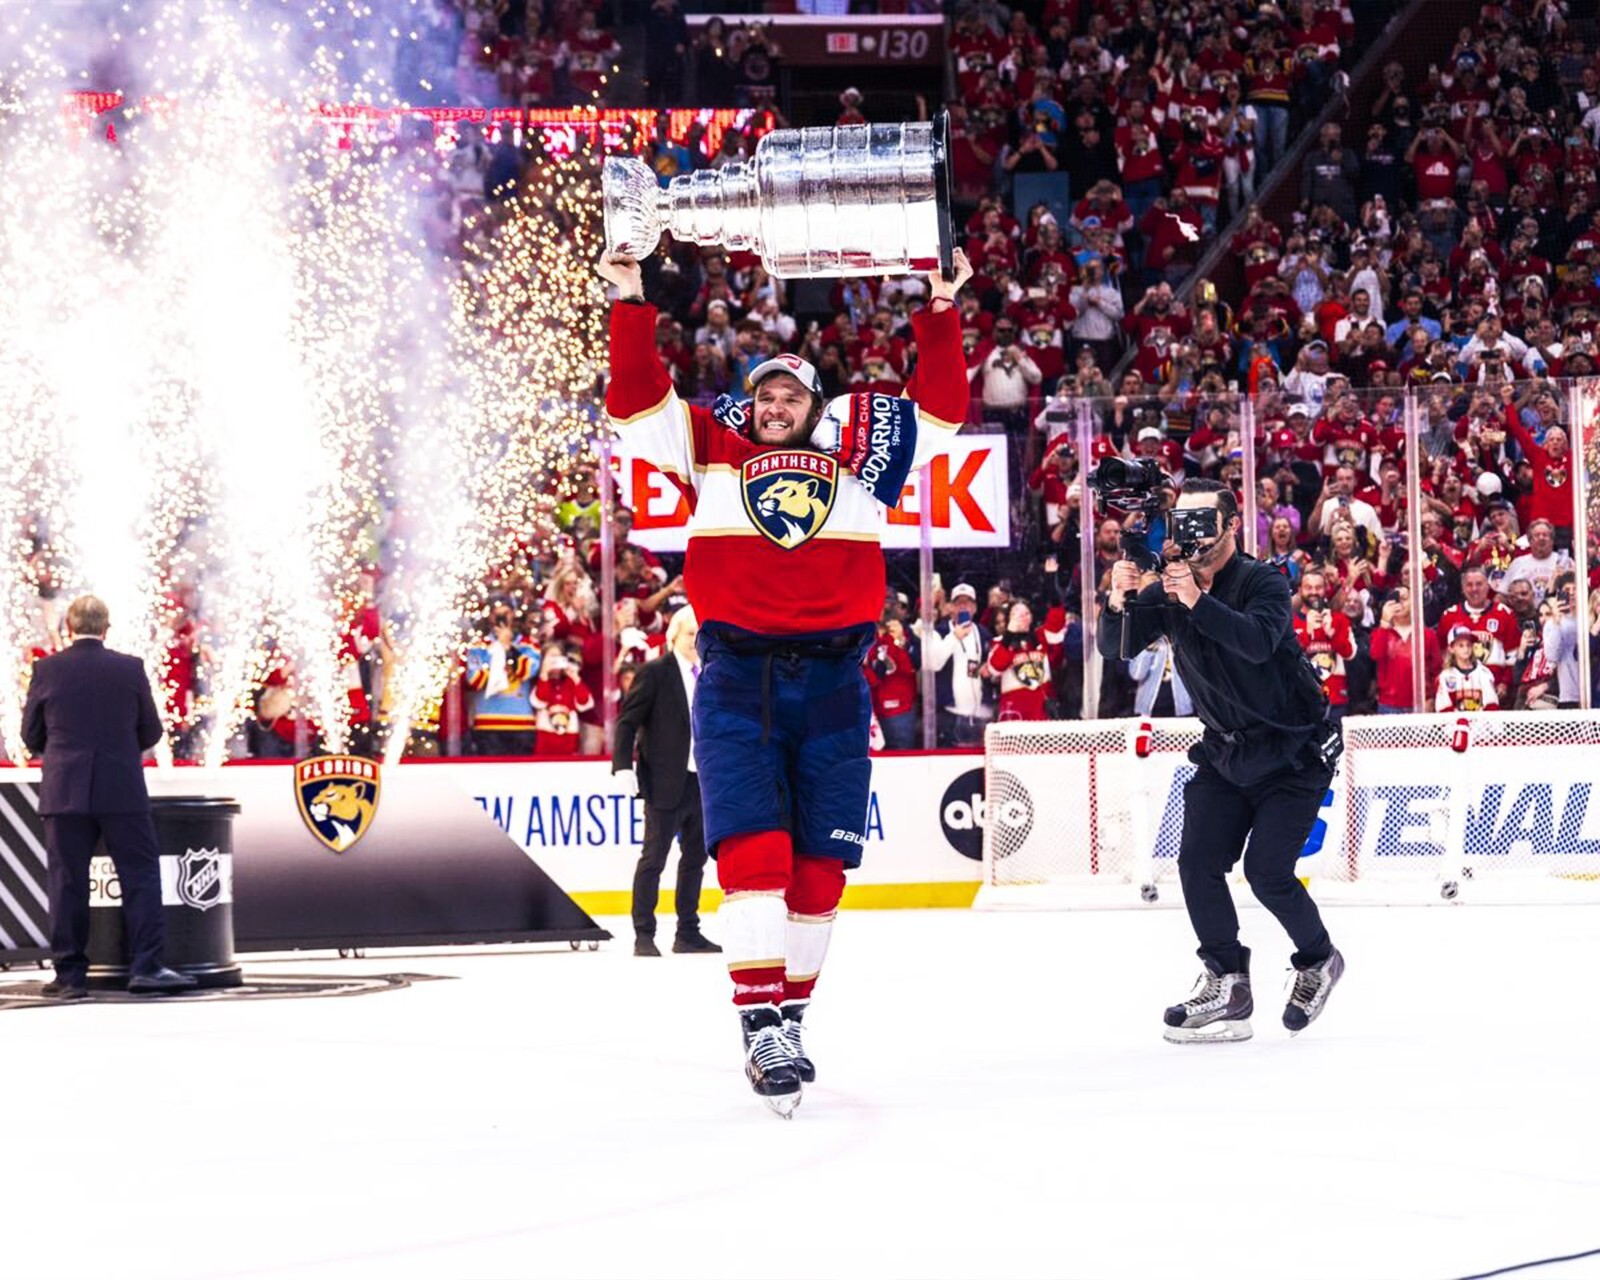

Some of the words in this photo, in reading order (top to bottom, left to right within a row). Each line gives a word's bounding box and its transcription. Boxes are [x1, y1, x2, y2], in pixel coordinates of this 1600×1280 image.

[880, 29, 929, 58] 130
[860, 392, 892, 496] BODYARMO
[751, 455, 829, 477] PANTHERS
[303, 759, 374, 780] FLORIDA
[525, 794, 645, 847] AMSTE
[191, 860, 219, 898] NHL
